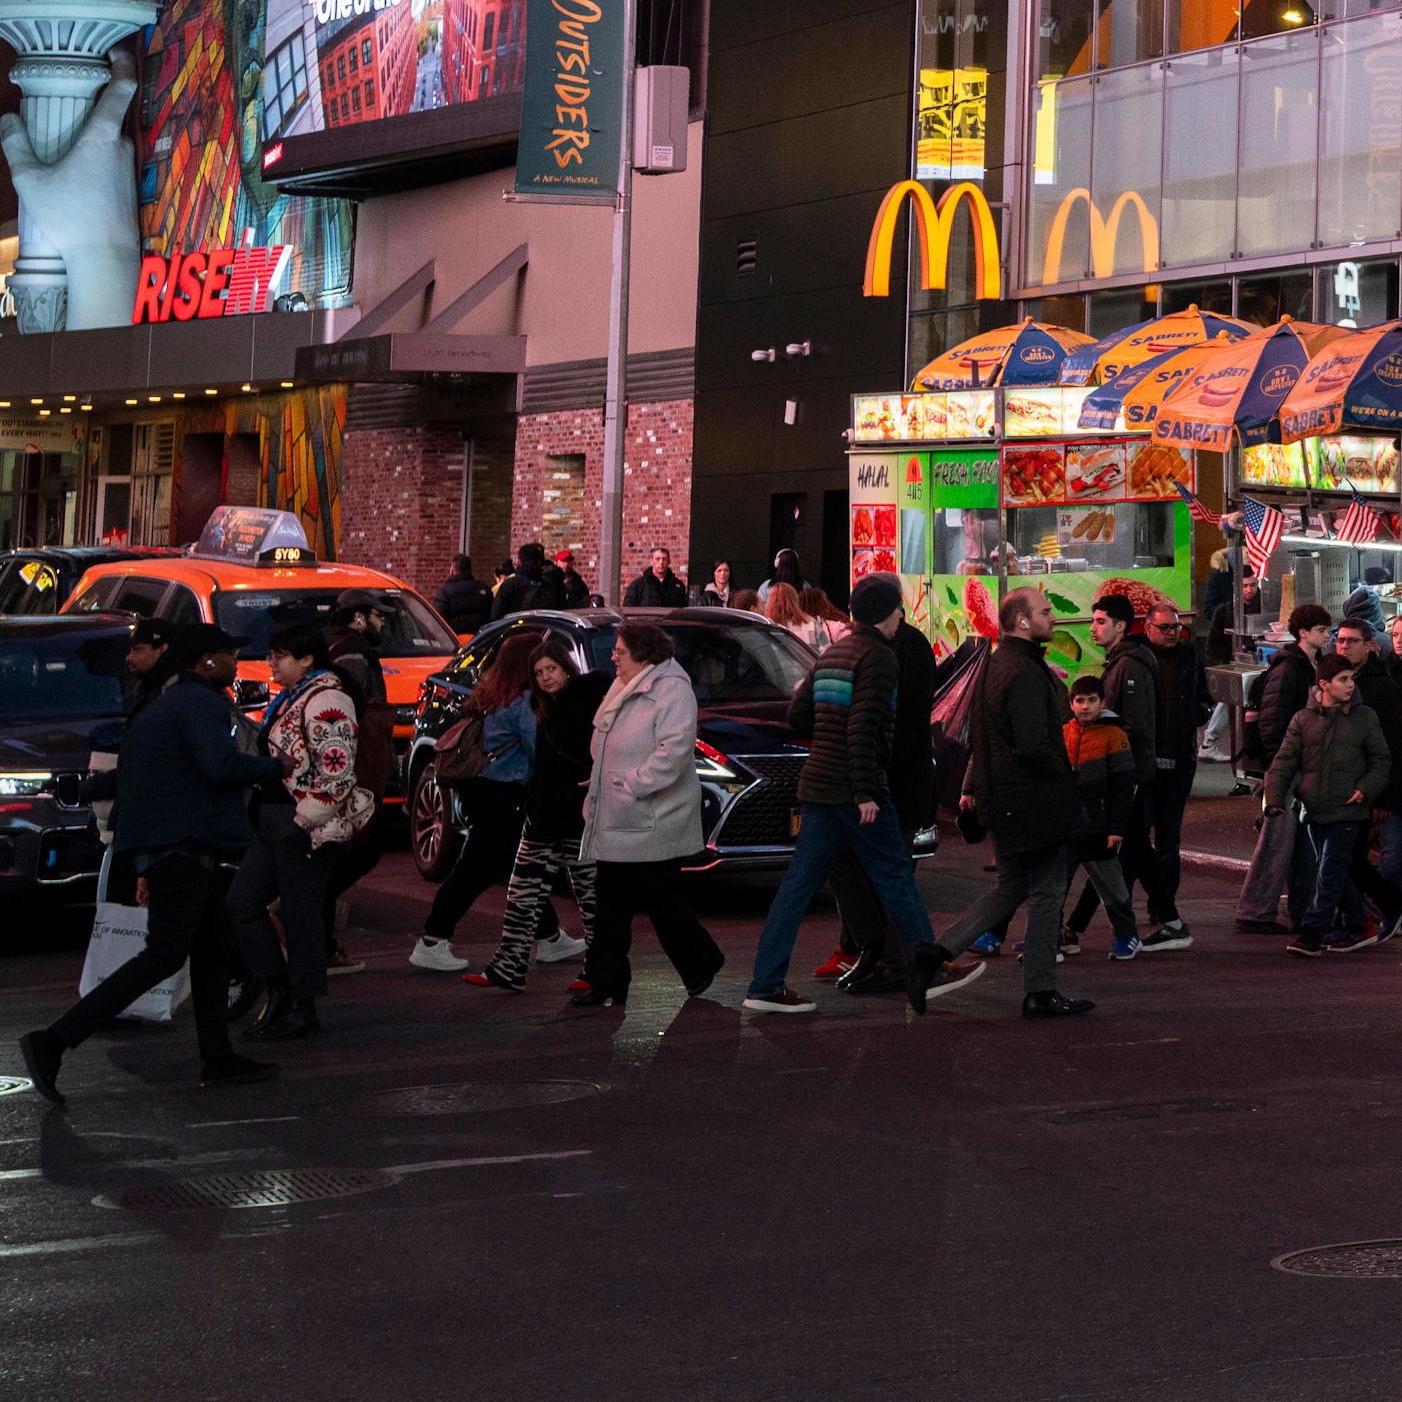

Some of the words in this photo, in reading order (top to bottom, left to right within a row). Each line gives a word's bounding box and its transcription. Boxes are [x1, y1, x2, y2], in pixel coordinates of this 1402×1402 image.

[533, 174, 541, 183] A
[543, 174, 562, 183] NEW
[565, 175, 600, 184] MUSICAL
[132, 248, 235, 325] RISE
[1129, 332, 1200, 347] SABRETT
[948, 345, 1008, 361] SABRETT
[1189, 367, 1250, 390] SABRETT
[1305, 354, 1364, 383] SABRETT
[1283, 403, 1342, 437] SABRETT
[1377, 407, 1389, 417] ON
[1156, 419, 1233, 445] SABRETT
[857, 462, 890, 489] HALAL
[101, 926, 110, 935] OF
